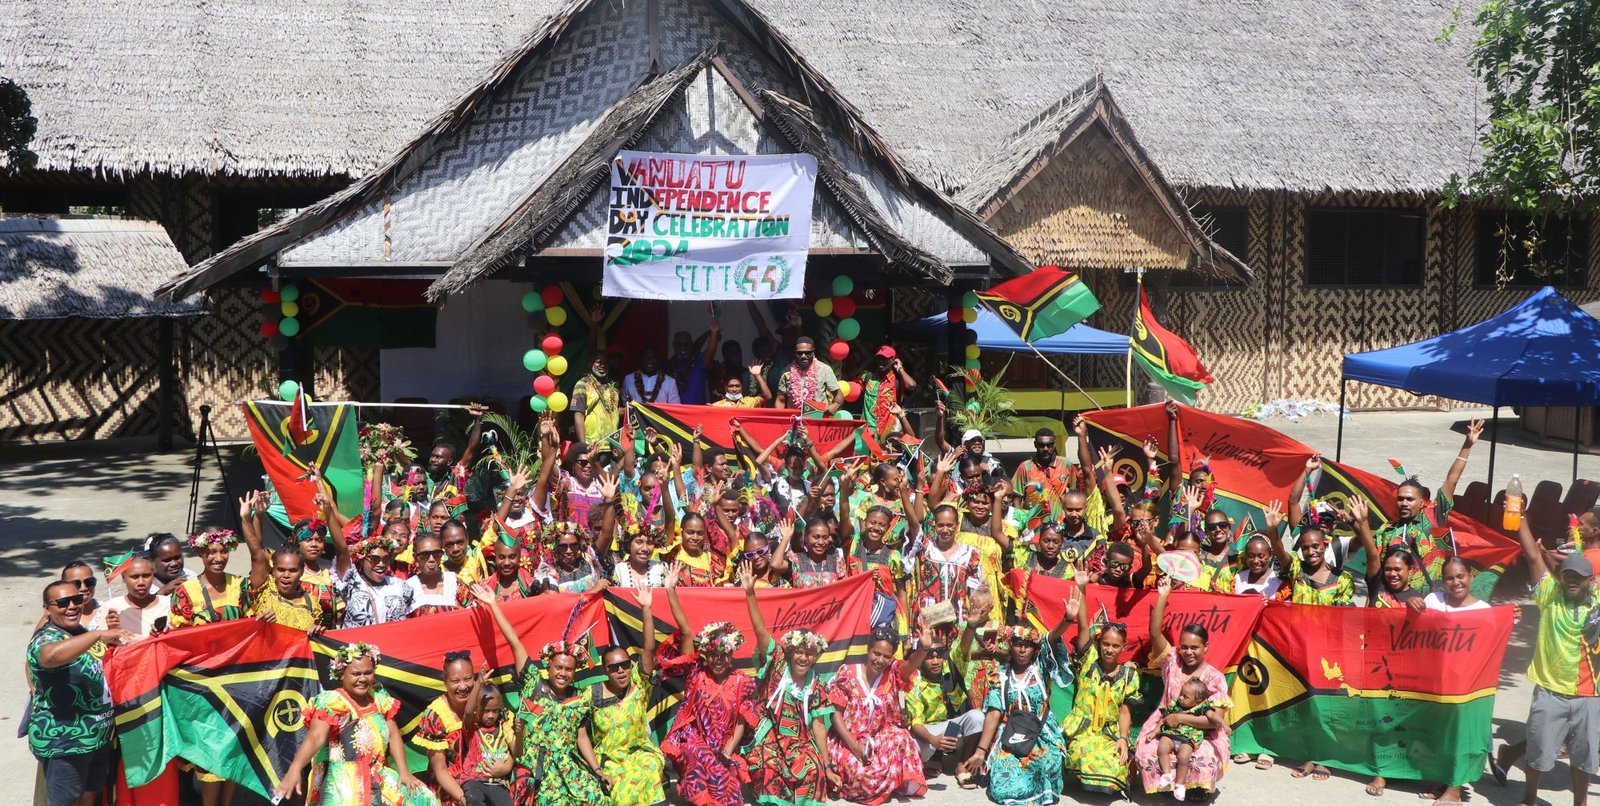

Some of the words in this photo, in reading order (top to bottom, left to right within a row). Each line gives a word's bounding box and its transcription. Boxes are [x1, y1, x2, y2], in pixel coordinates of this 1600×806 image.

[615, 158, 746, 190] VANUATU
[610, 187, 772, 213] INDEPENDENCE
[609, 209, 649, 235] DAY
[652, 212, 790, 239] CELEBRATION
[818, 421, 855, 443] Vanu
[1201, 431, 1273, 471] Vanuatu
[1389, 621, 1481, 653] Vanuatu
